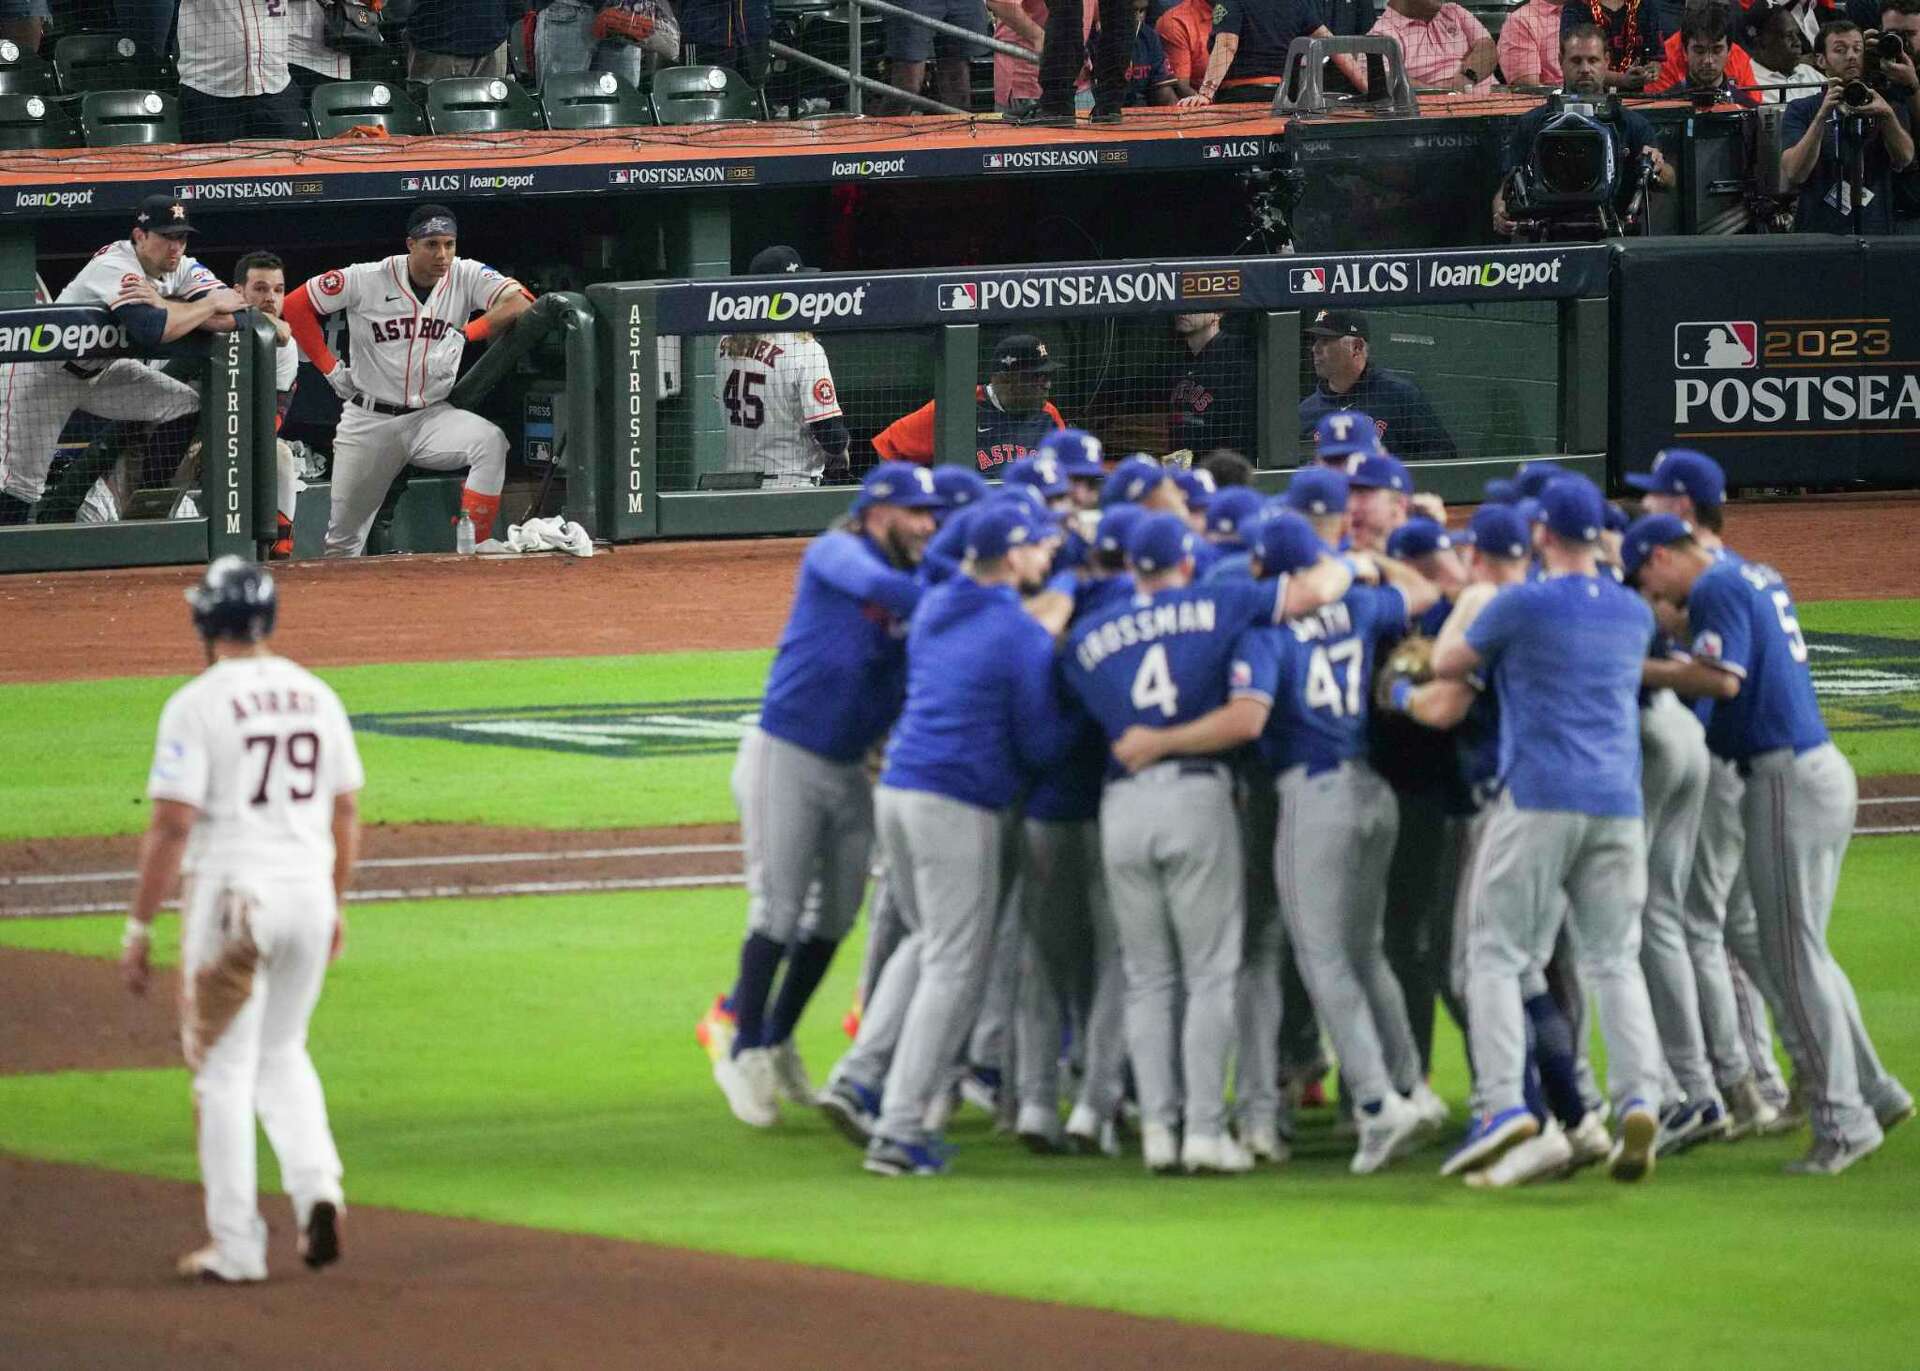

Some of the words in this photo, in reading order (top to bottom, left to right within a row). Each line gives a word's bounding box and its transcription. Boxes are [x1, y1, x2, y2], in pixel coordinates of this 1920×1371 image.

[1003, 150, 1098, 168] POSTSEASON
[1222, 141, 1258, 158] ALCS
[630, 166, 726, 184] POSTSEASON
[727, 168, 755, 178] 2023
[832, 158, 905, 177] loanDepot
[196, 182, 294, 200] POSTSEASON
[421, 175, 460, 191] ALCS
[469, 173, 534, 189] loanDepot
[16, 189, 93, 208] loanDepot
[1330, 261, 1408, 294] ALCS
[1429, 257, 1561, 290] loanDepot
[708, 285, 866, 324] loanDepot
[980, 272, 1177, 311] POSTSEASON
[1182, 275, 1240, 293] 2023
[1764, 329, 1891, 357] 2023
[528, 406, 551, 417] PRESS
[723, 369, 767, 430] 45
[1675, 375, 1920, 424] POSTSEA
[1131, 643, 1179, 717] 4
[1306, 638, 1363, 718] 47
[244, 731, 320, 807] 79
